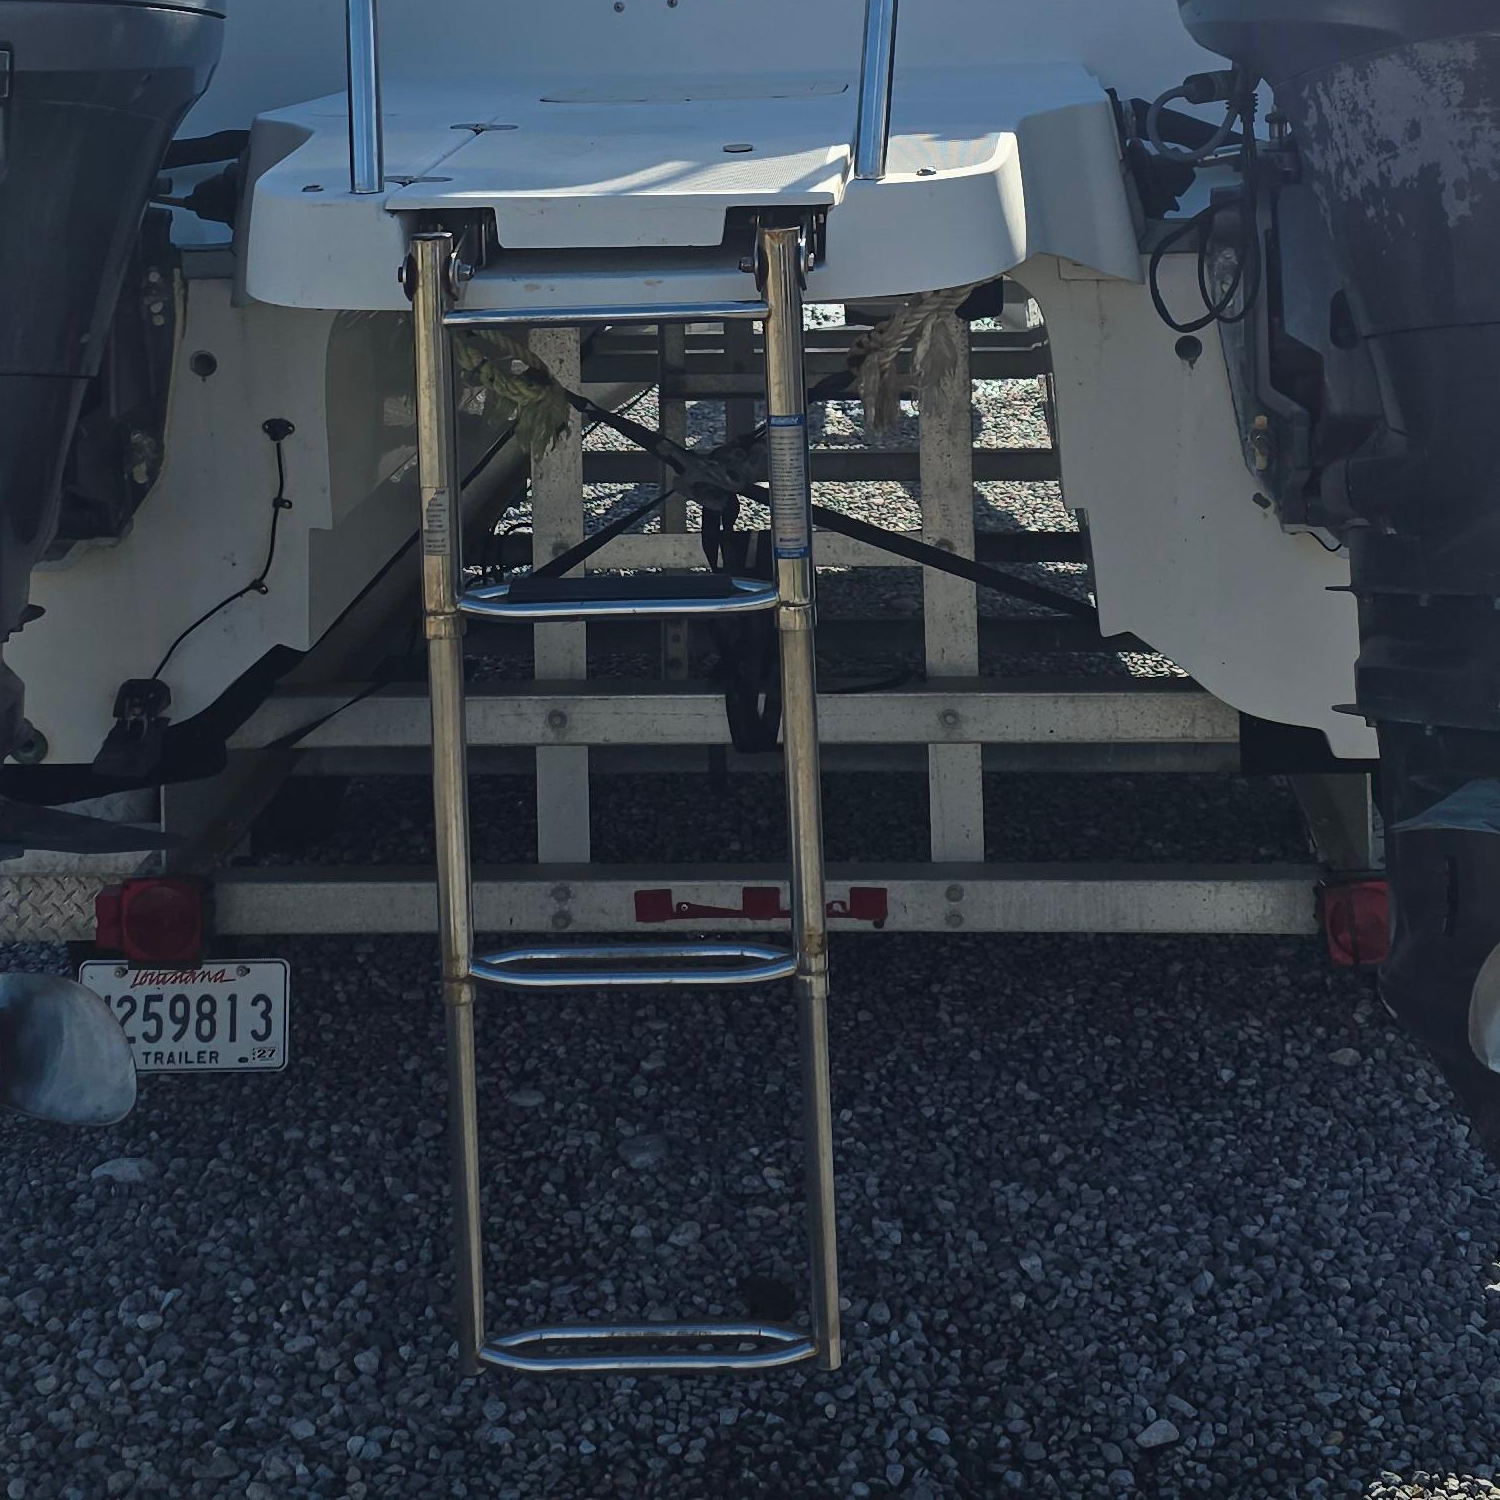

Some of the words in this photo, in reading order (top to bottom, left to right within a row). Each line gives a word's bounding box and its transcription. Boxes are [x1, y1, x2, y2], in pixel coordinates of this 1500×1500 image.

[104, 993, 273, 1044] 259813
[142, 1050, 219, 1065] TRAILER
[257, 1049, 276, 1059] 27
